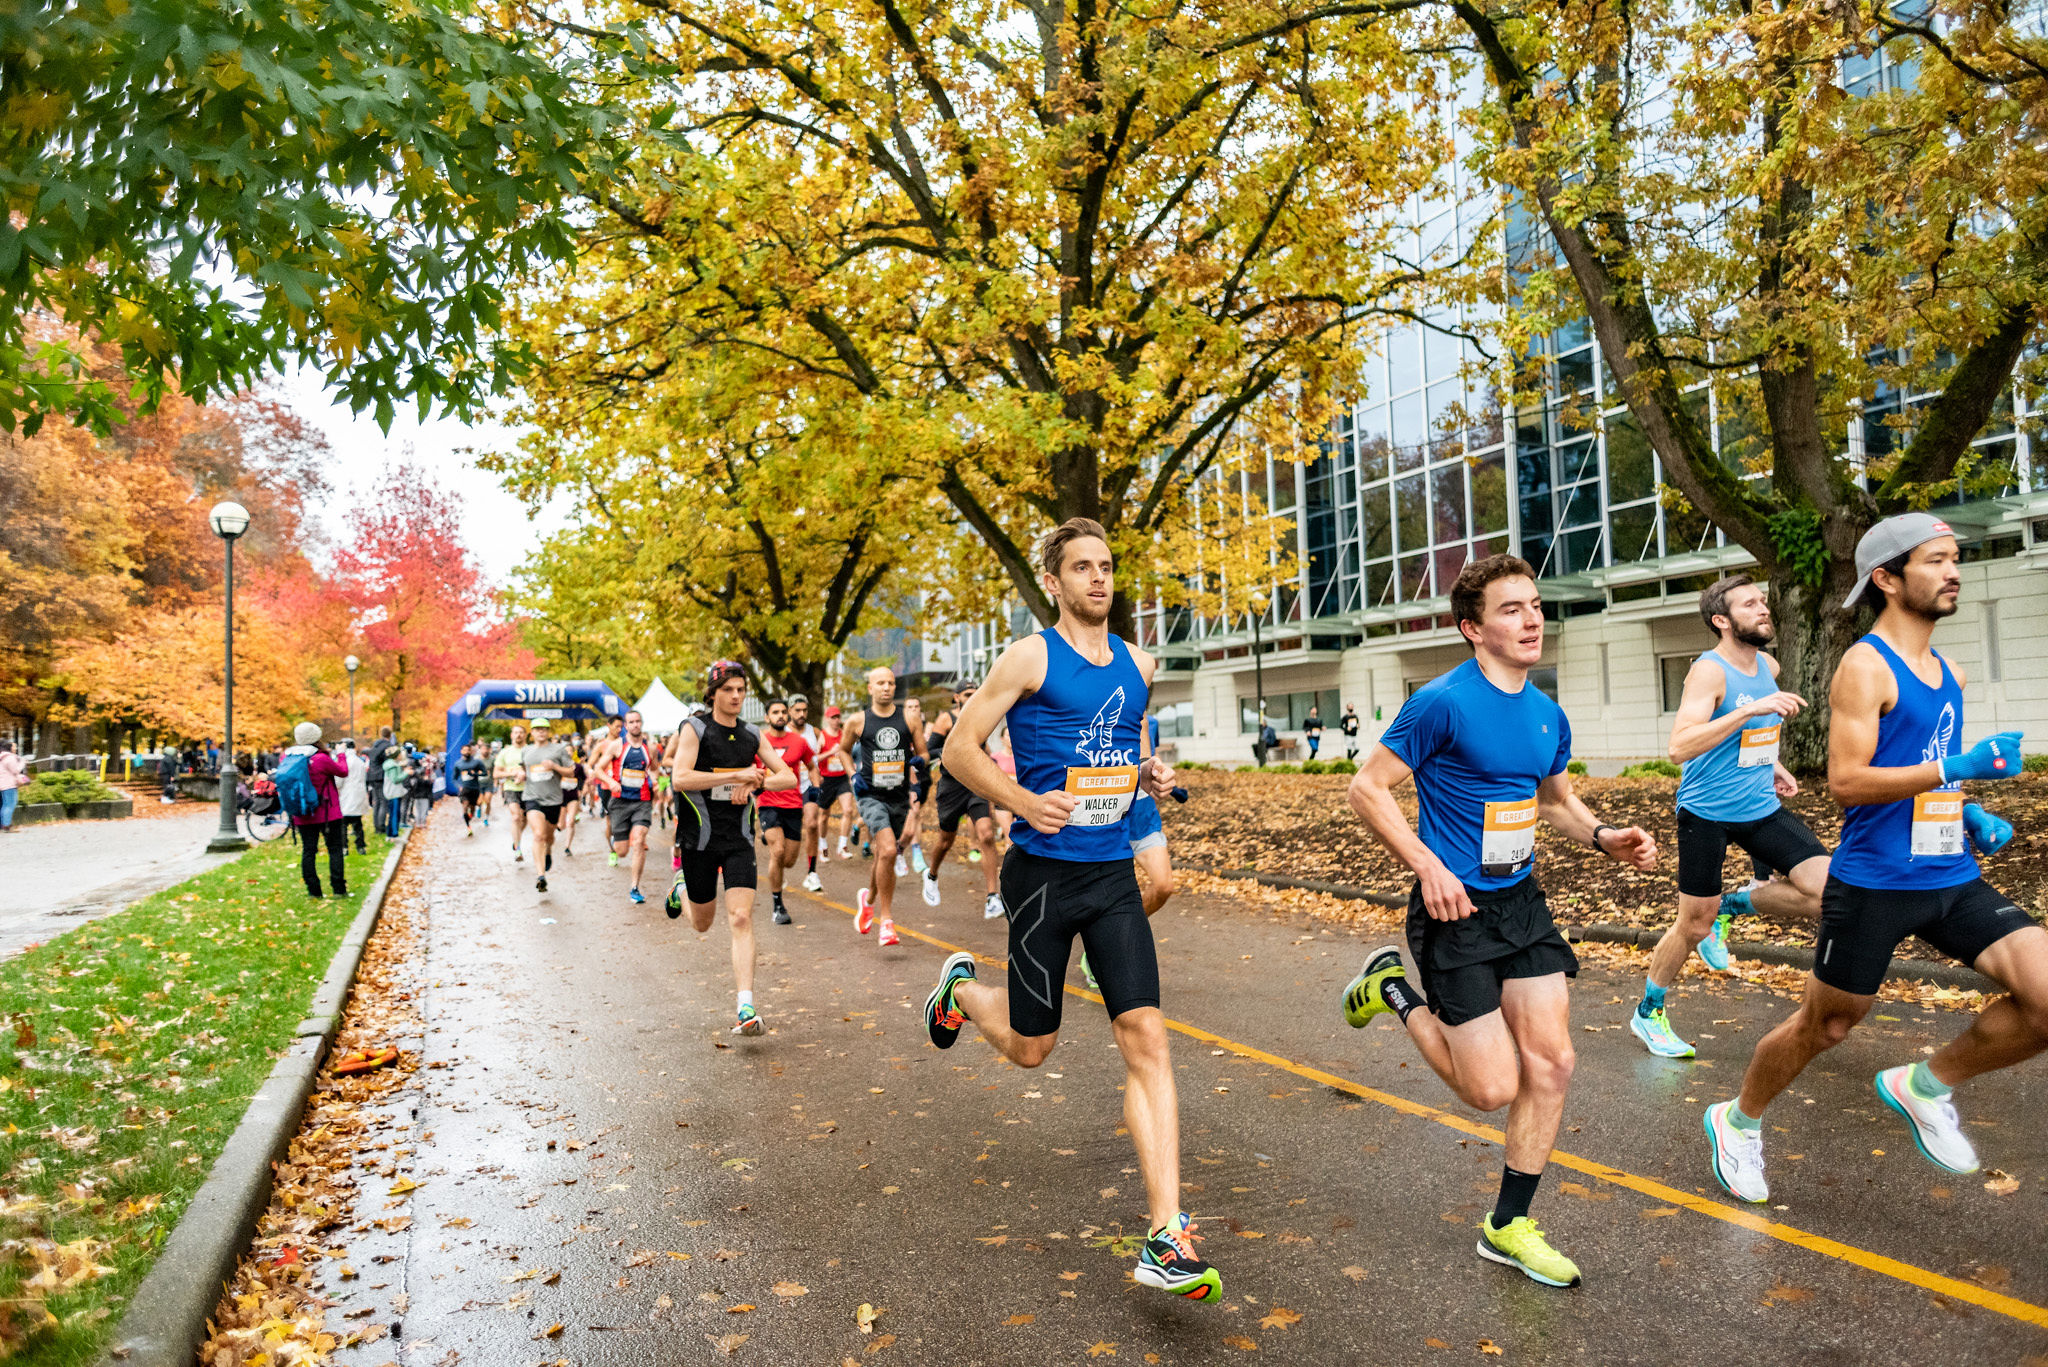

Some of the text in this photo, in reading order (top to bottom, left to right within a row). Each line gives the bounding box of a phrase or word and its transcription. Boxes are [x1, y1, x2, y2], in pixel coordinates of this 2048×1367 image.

[515, 682, 567, 702] START
[1088, 748, 1134, 768] VFAC
[1085, 777, 1128, 787] GREAT TREK
[1085, 798, 1119, 810] WALKER
[1090, 813, 1110, 825] 2001
[1503, 811, 1525, 822] GREAT
